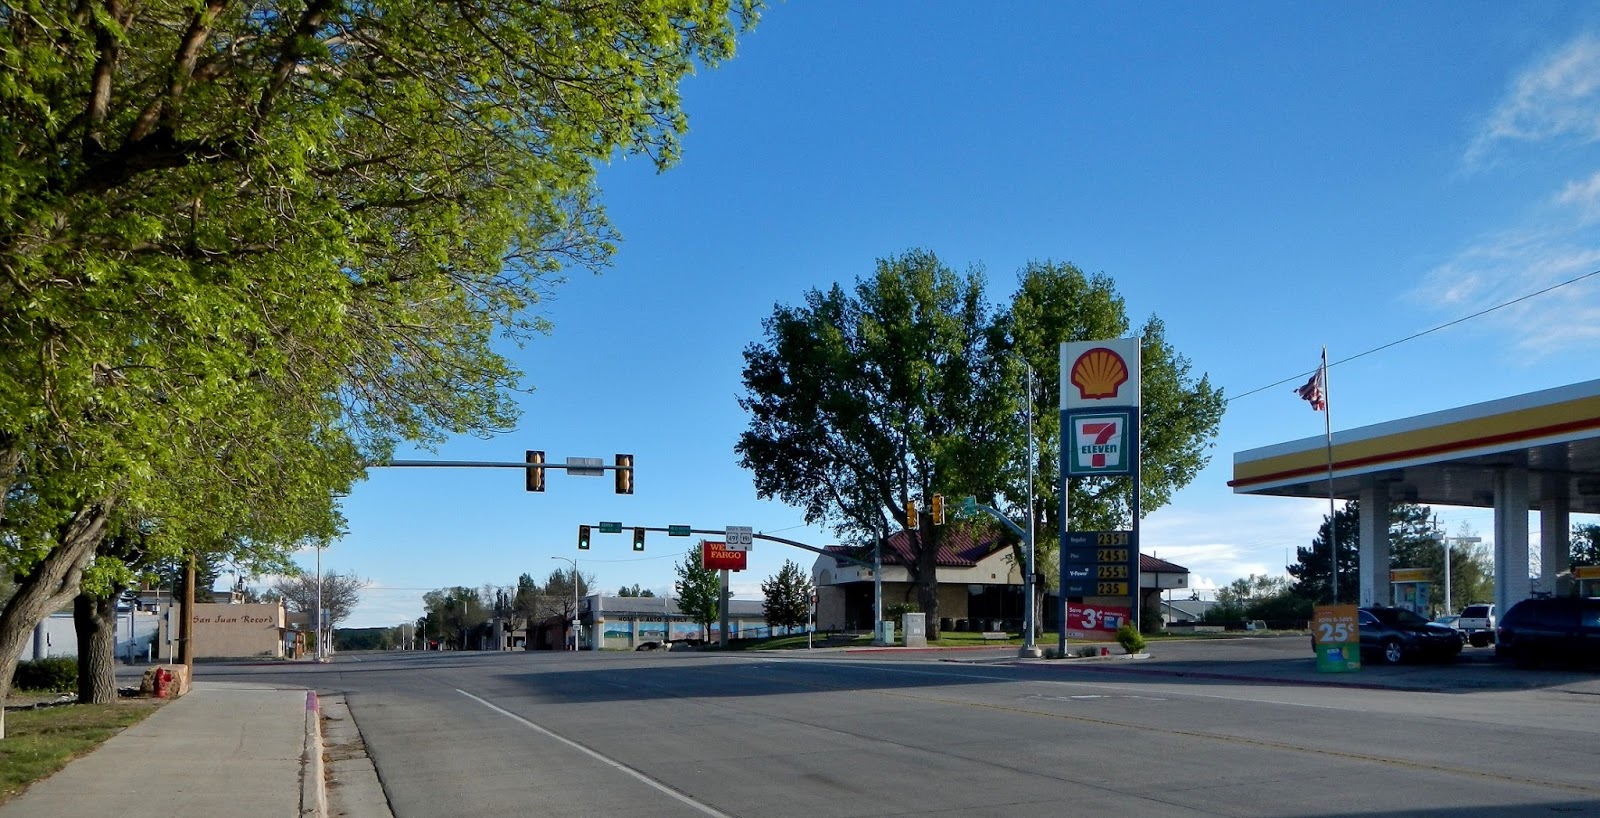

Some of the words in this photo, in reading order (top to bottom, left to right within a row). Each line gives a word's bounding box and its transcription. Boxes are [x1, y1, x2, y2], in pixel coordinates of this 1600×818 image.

[1083, 422, 1116, 467] 7
[1099, 533, 1119, 545] 235
[711, 551, 741, 559] FARGO
[1099, 550, 1119, 561] 245
[1099, 566, 1119, 577] 255
[1099, 583, 1119, 594] 235
[193, 615, 210, 623] San
[214, 615, 237, 623] Juan
[241, 615, 273, 623] Record
